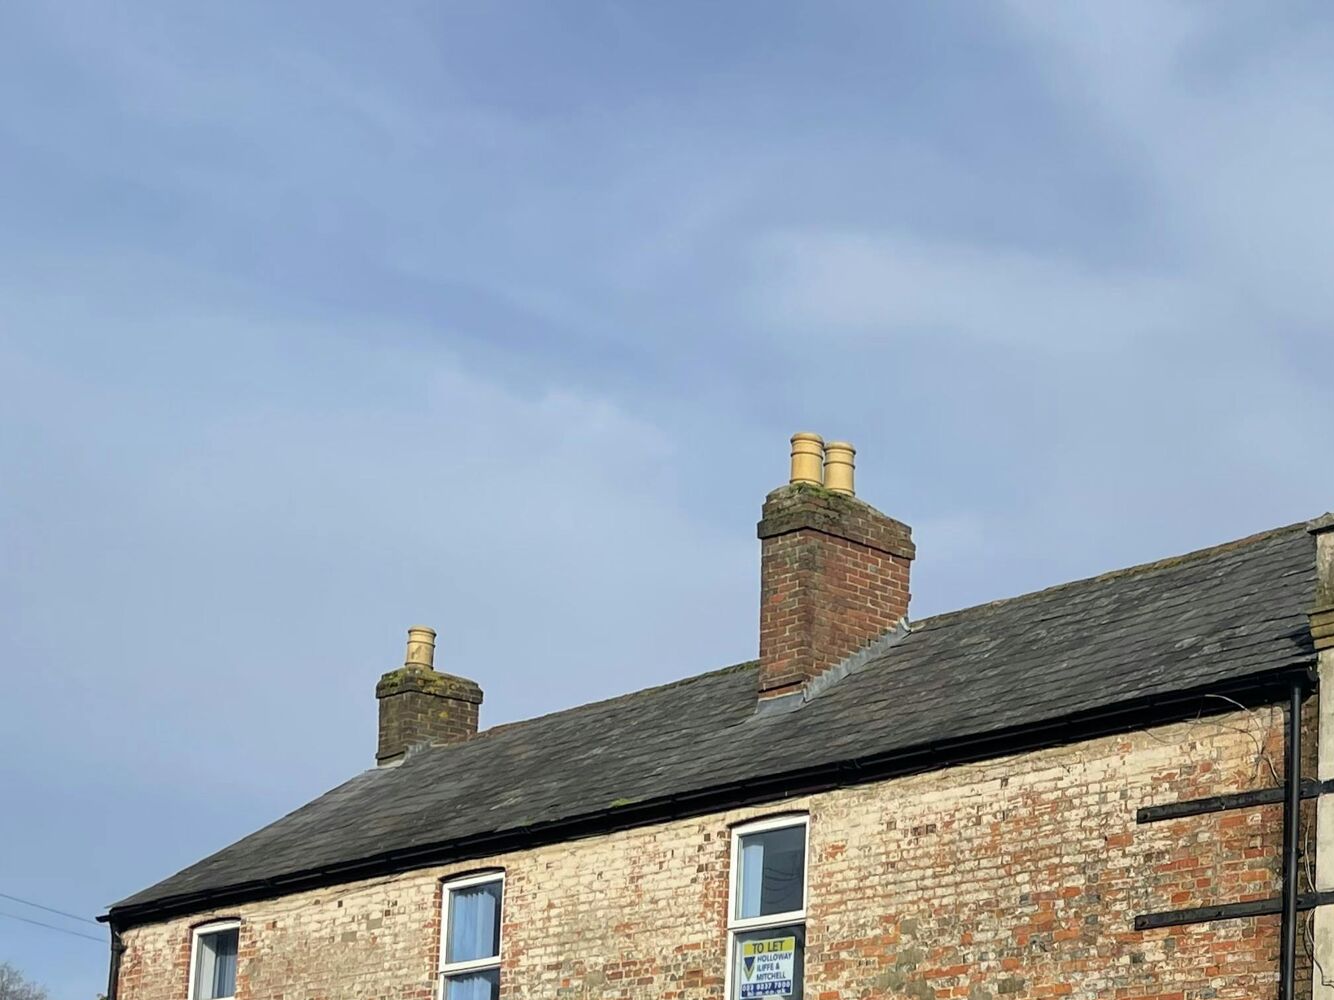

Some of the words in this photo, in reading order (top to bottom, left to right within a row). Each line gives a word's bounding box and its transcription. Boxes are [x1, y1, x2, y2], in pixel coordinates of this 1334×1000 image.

[752, 943, 764, 954] TO
[767, 941, 785, 951] LET
[757, 953, 791, 962] HOLLOWAY
[756, 971, 786, 981] MITCHELL
